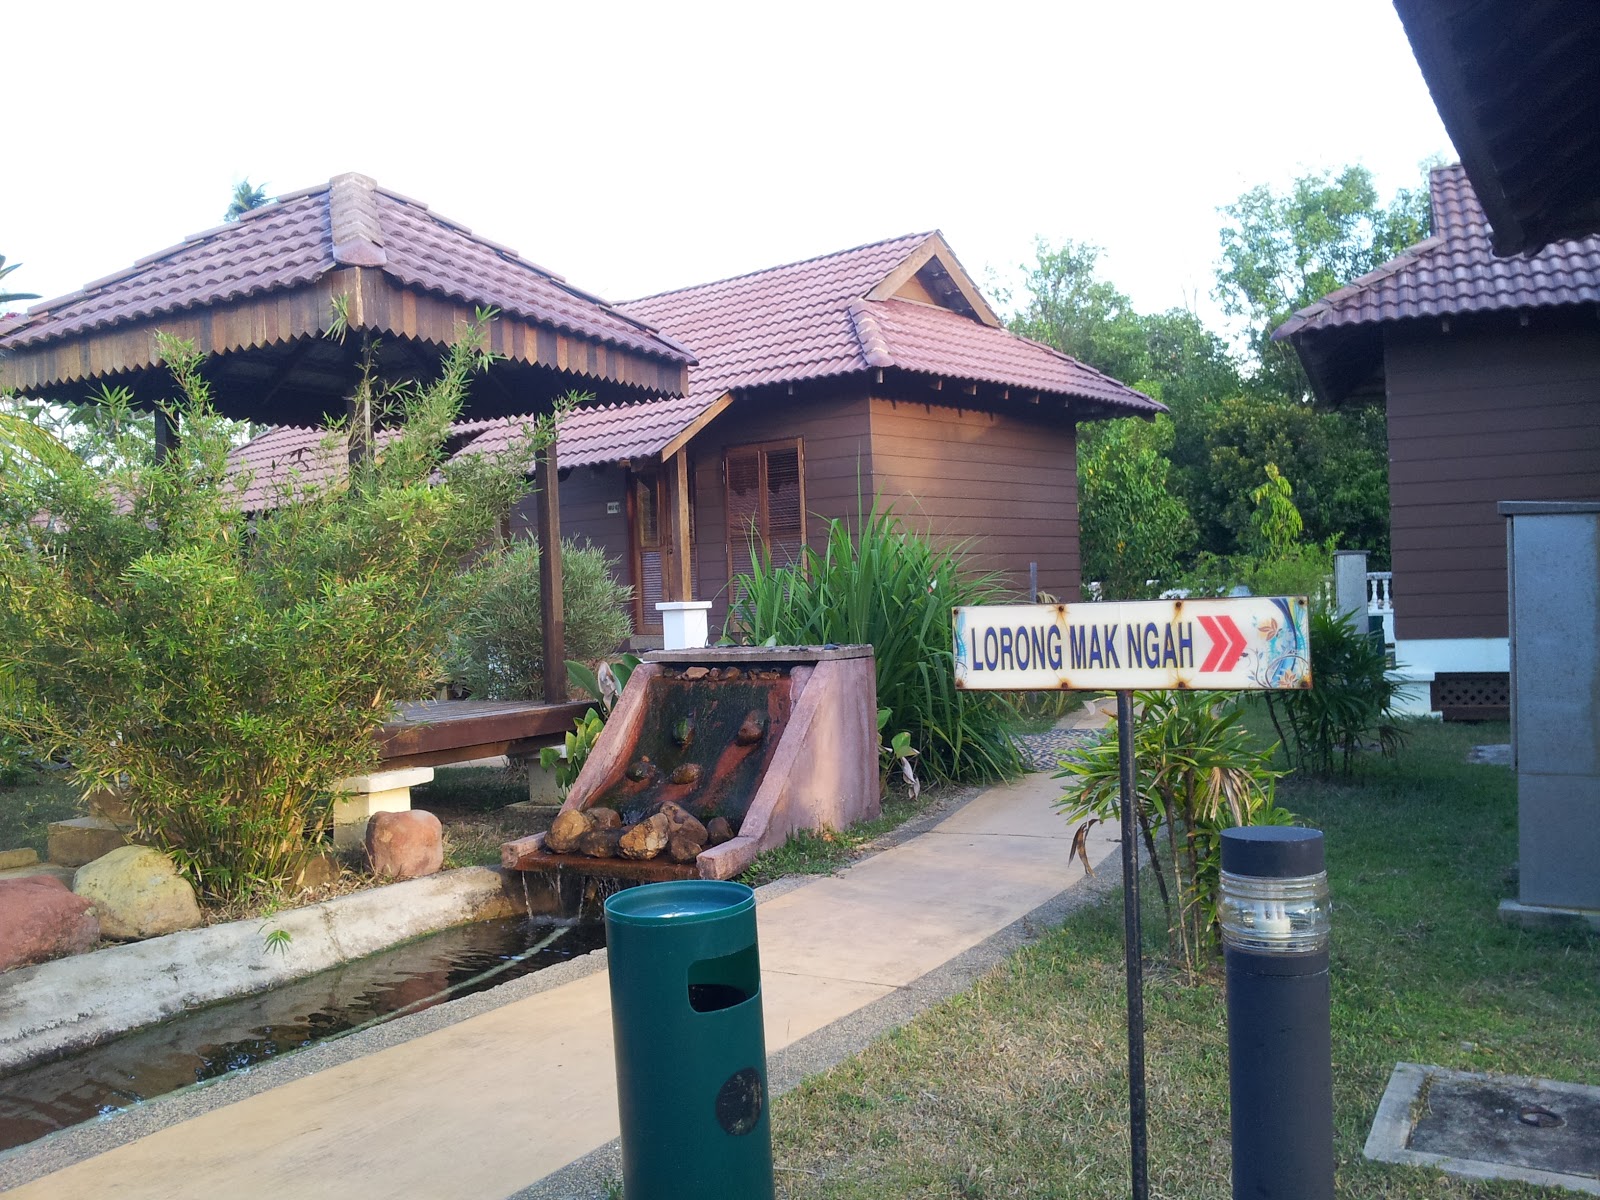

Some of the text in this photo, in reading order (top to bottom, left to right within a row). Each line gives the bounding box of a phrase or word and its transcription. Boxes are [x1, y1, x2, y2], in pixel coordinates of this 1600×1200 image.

[971, 622, 1194, 671] LORONG MAK NGAH
